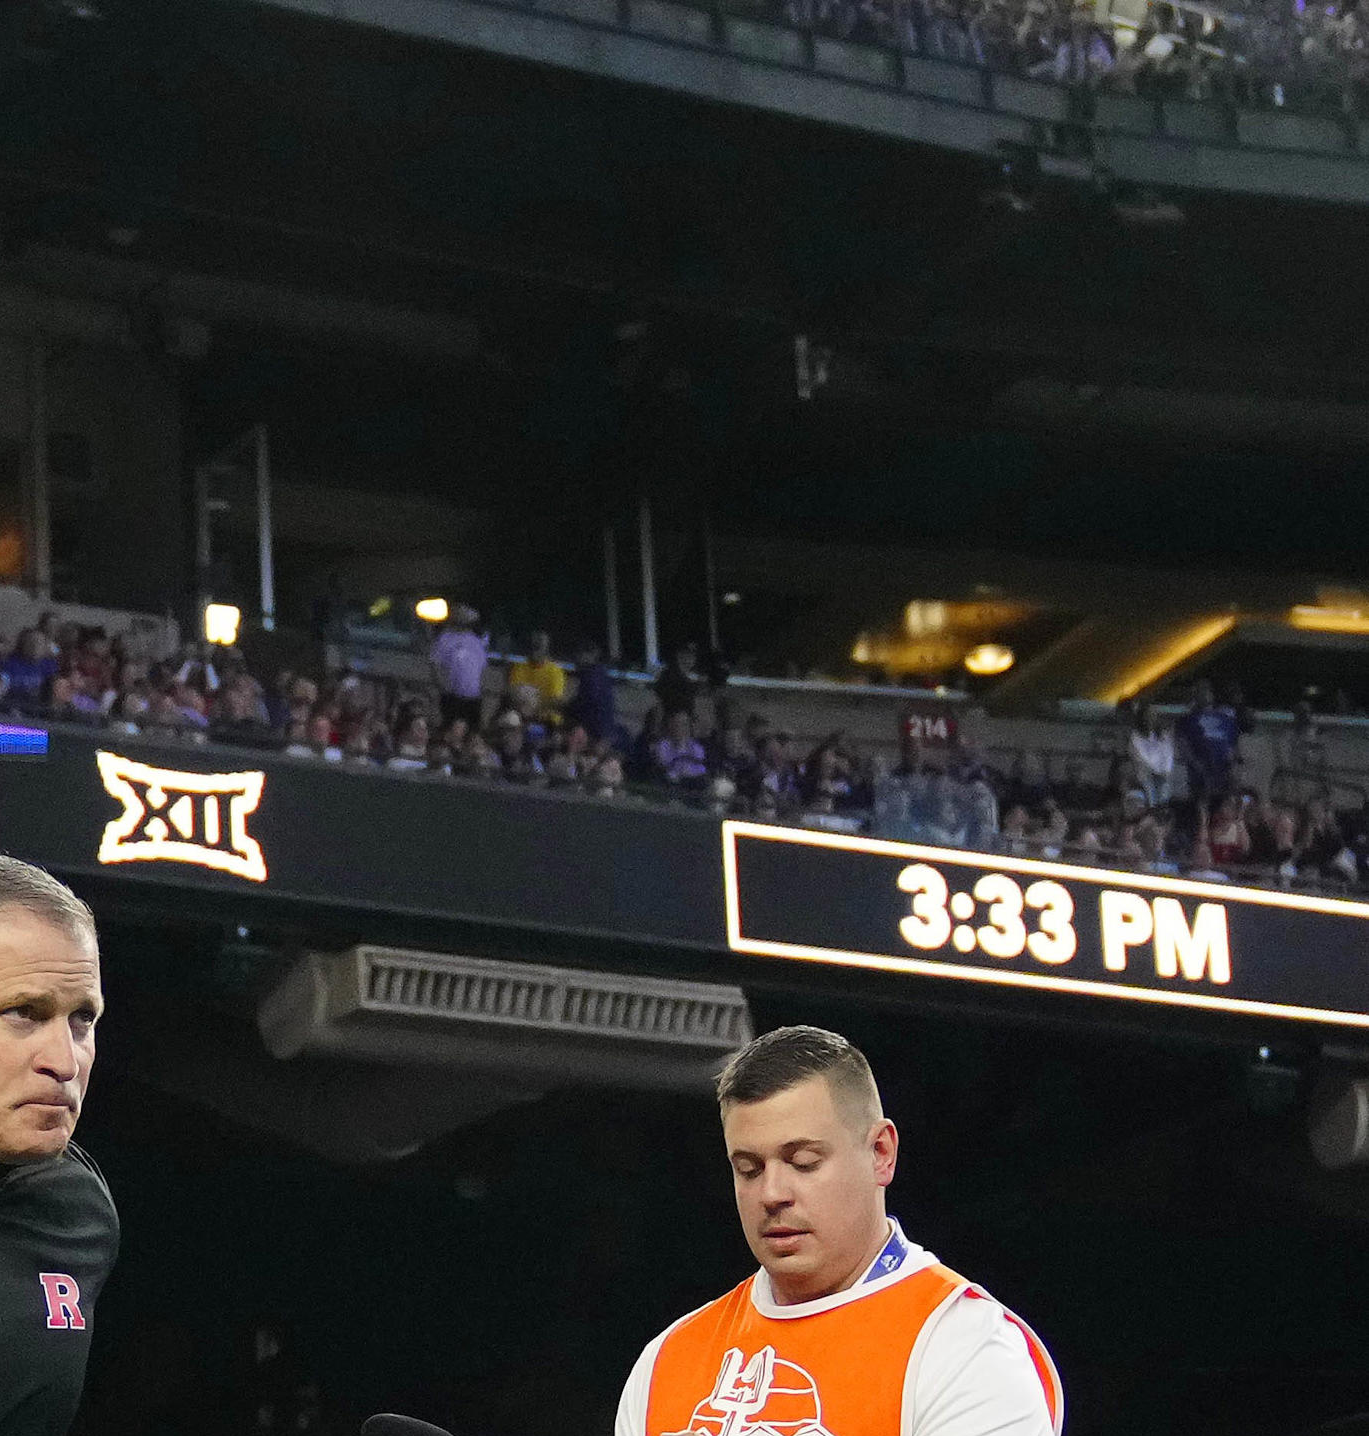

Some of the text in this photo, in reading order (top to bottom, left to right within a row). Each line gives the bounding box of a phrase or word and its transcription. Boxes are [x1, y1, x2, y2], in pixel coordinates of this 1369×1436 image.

[107, 762, 258, 872] XII
[898, 863, 1232, 985] 3:33 PM
[39, 1272, 87, 1330] R
